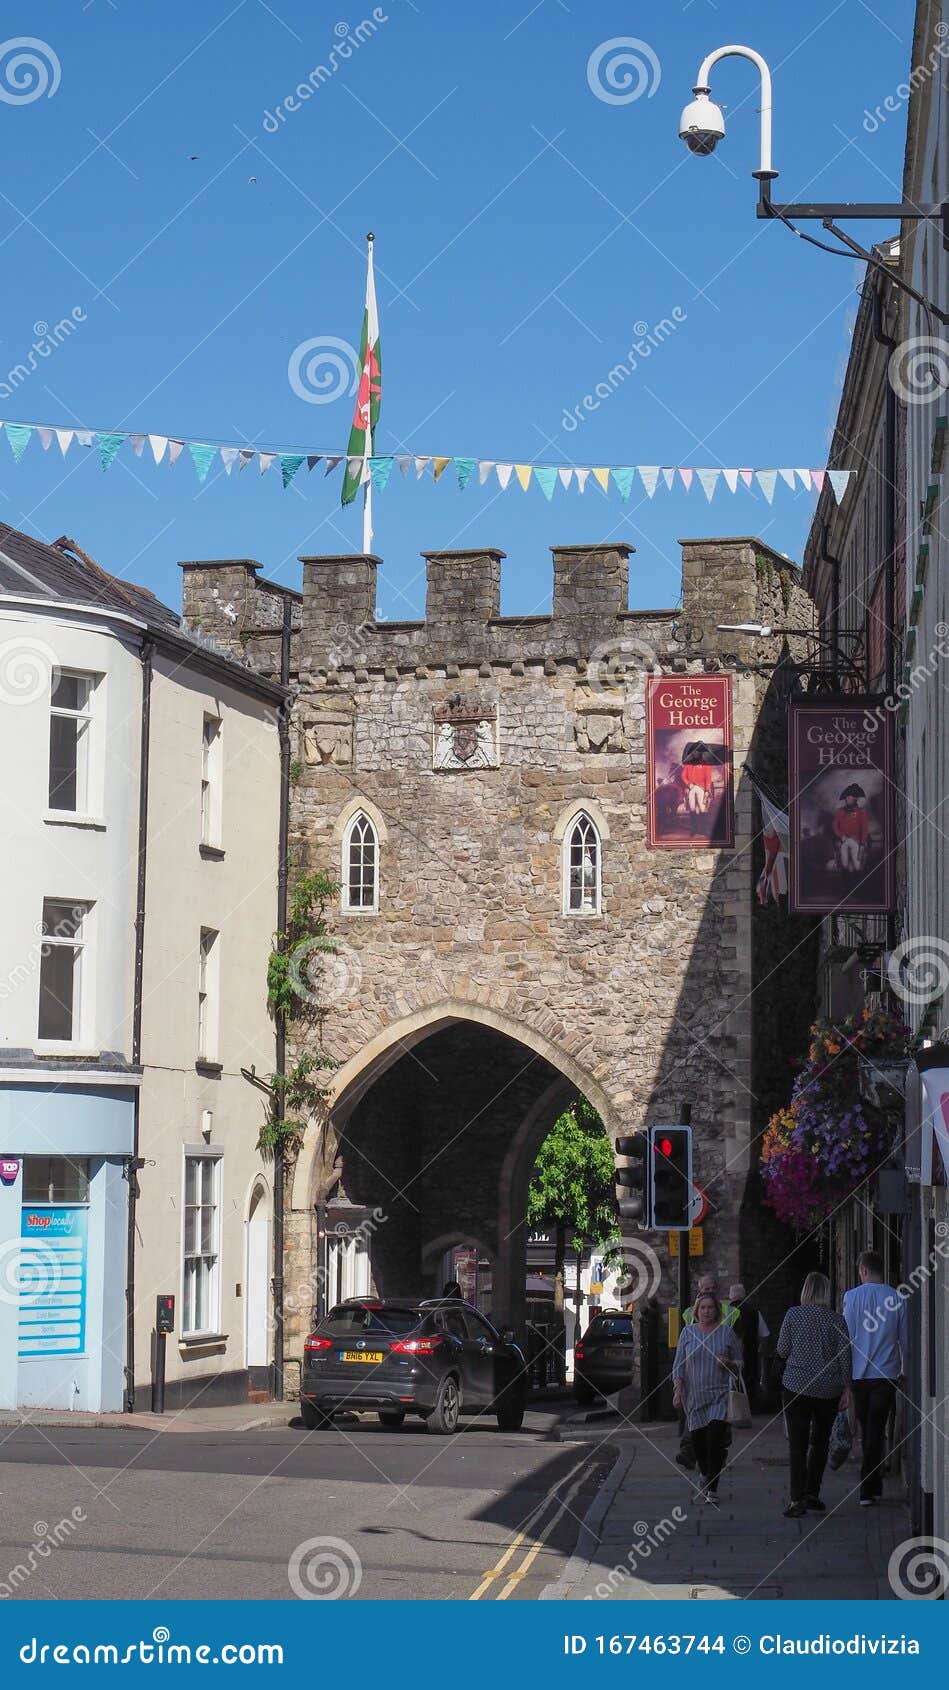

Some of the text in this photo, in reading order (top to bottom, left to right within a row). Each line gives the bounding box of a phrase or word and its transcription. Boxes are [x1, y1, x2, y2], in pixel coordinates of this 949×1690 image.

[680, 685, 702, 695] The
[659, 693, 718, 711] George
[668, 710, 714, 726] Hotel
[831, 716, 857, 729] The
[806, 726, 877, 748] George
[818, 747, 872, 766] Hotel
[27, 1214, 51, 1230] Shop
[365, 1353, 379, 1361] YXL
